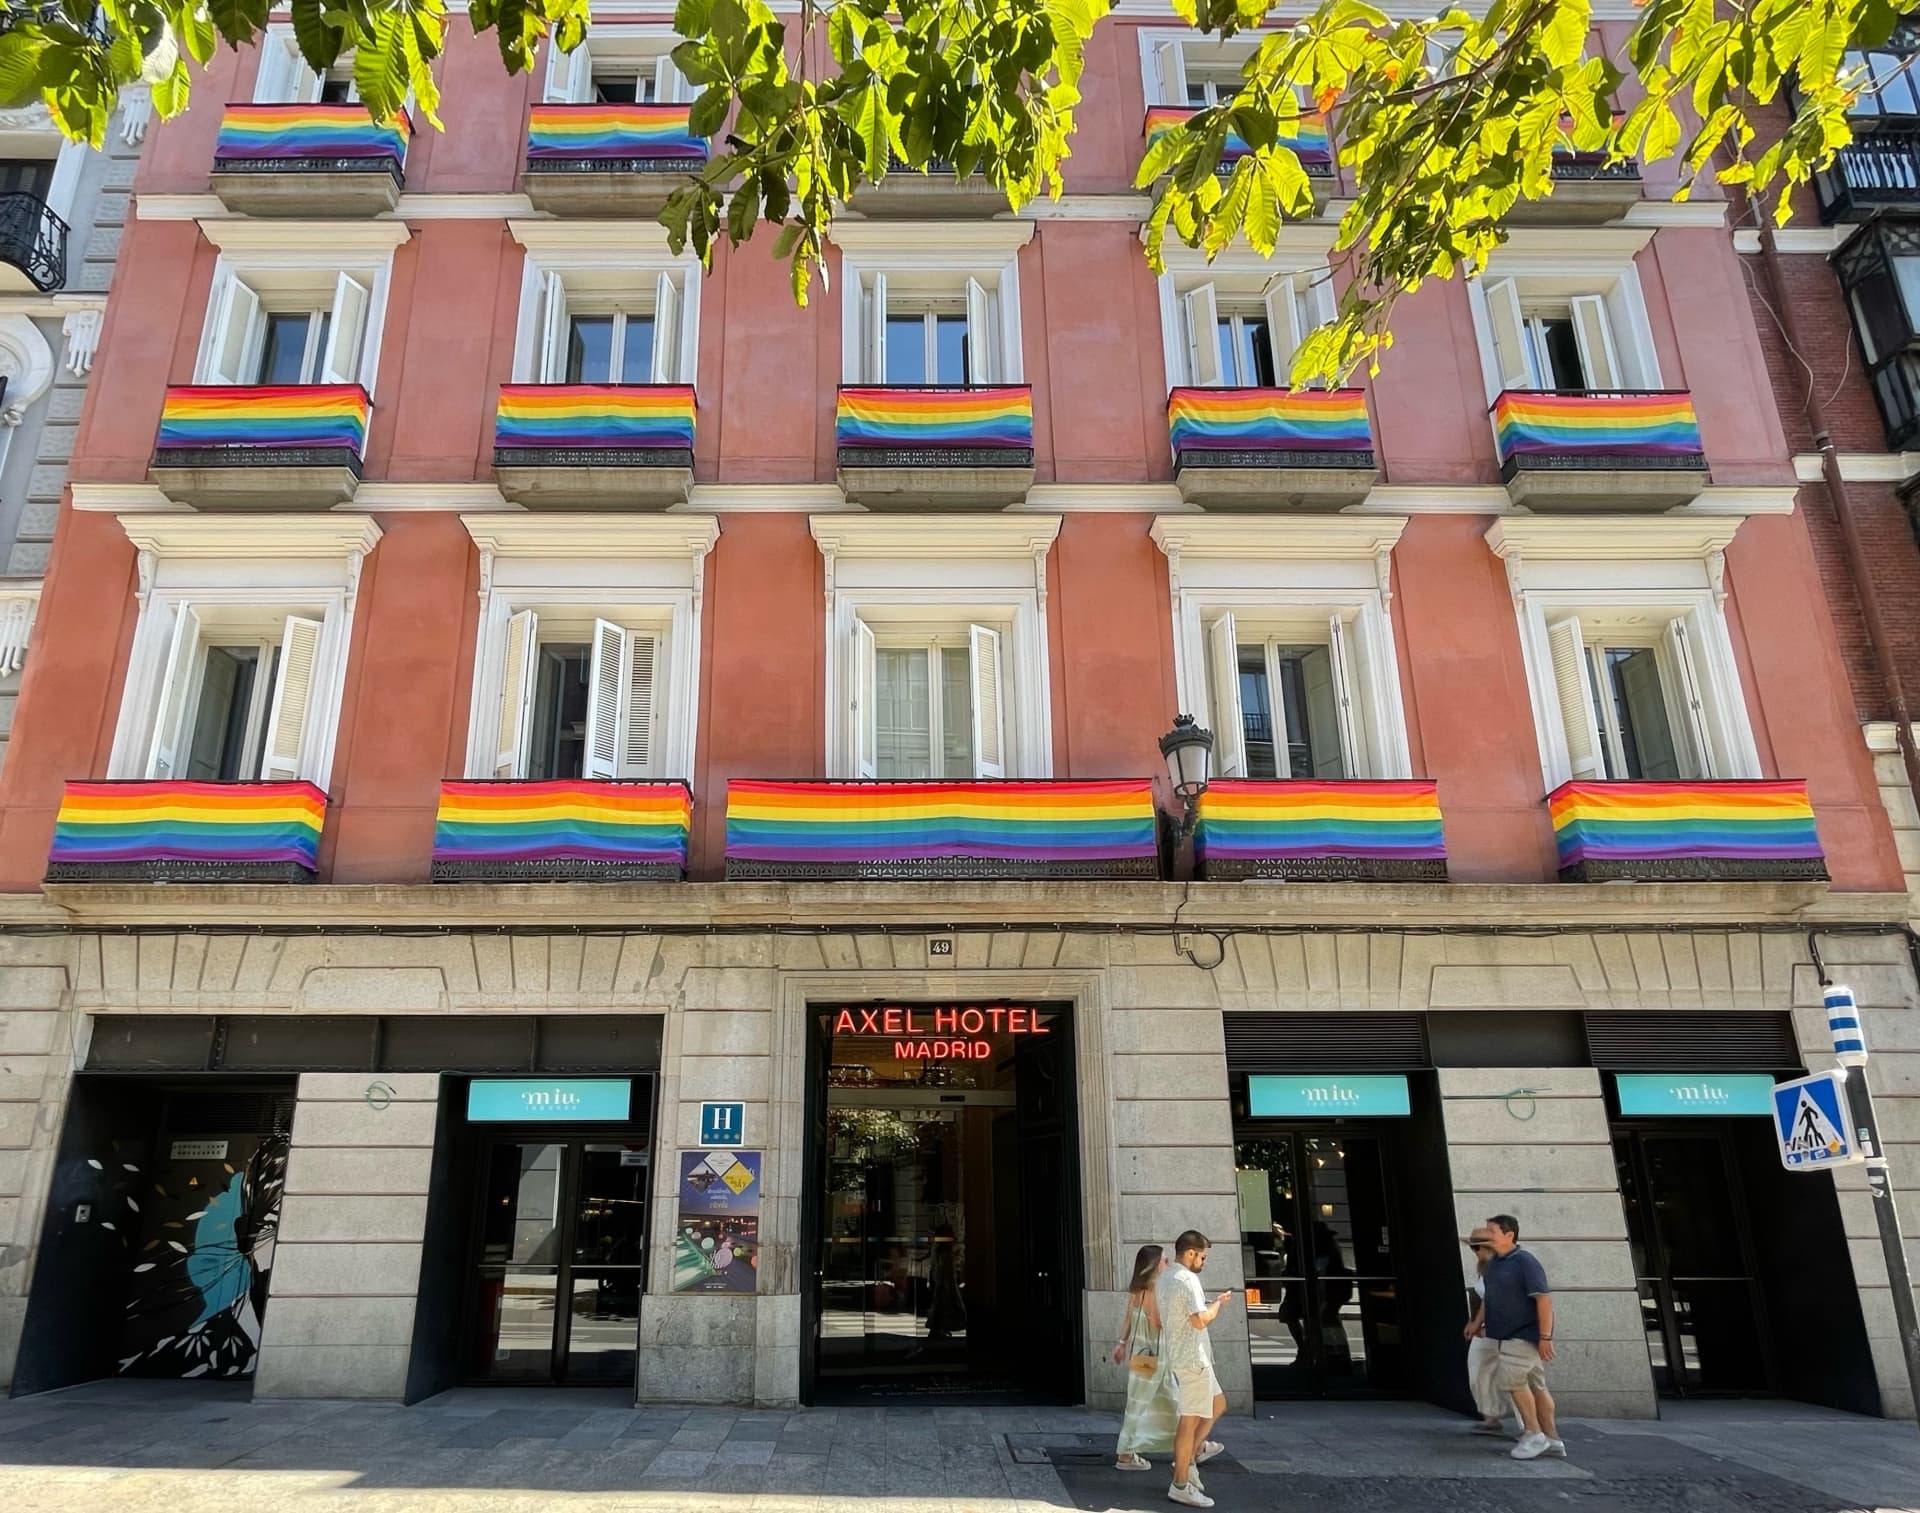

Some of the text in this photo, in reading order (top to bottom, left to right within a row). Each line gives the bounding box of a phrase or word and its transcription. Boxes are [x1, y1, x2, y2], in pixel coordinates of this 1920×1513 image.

[932, 941, 950, 953] 49
[835, 1006, 1050, 1034] AXEL HOTEL
[893, 1040, 992, 1060] MADRID
[521, 1087, 581, 1105] miu
[1301, 1084, 1360, 1101] miu
[1668, 1083, 1729, 1100] miu
[711, 1107, 734, 1130] H
